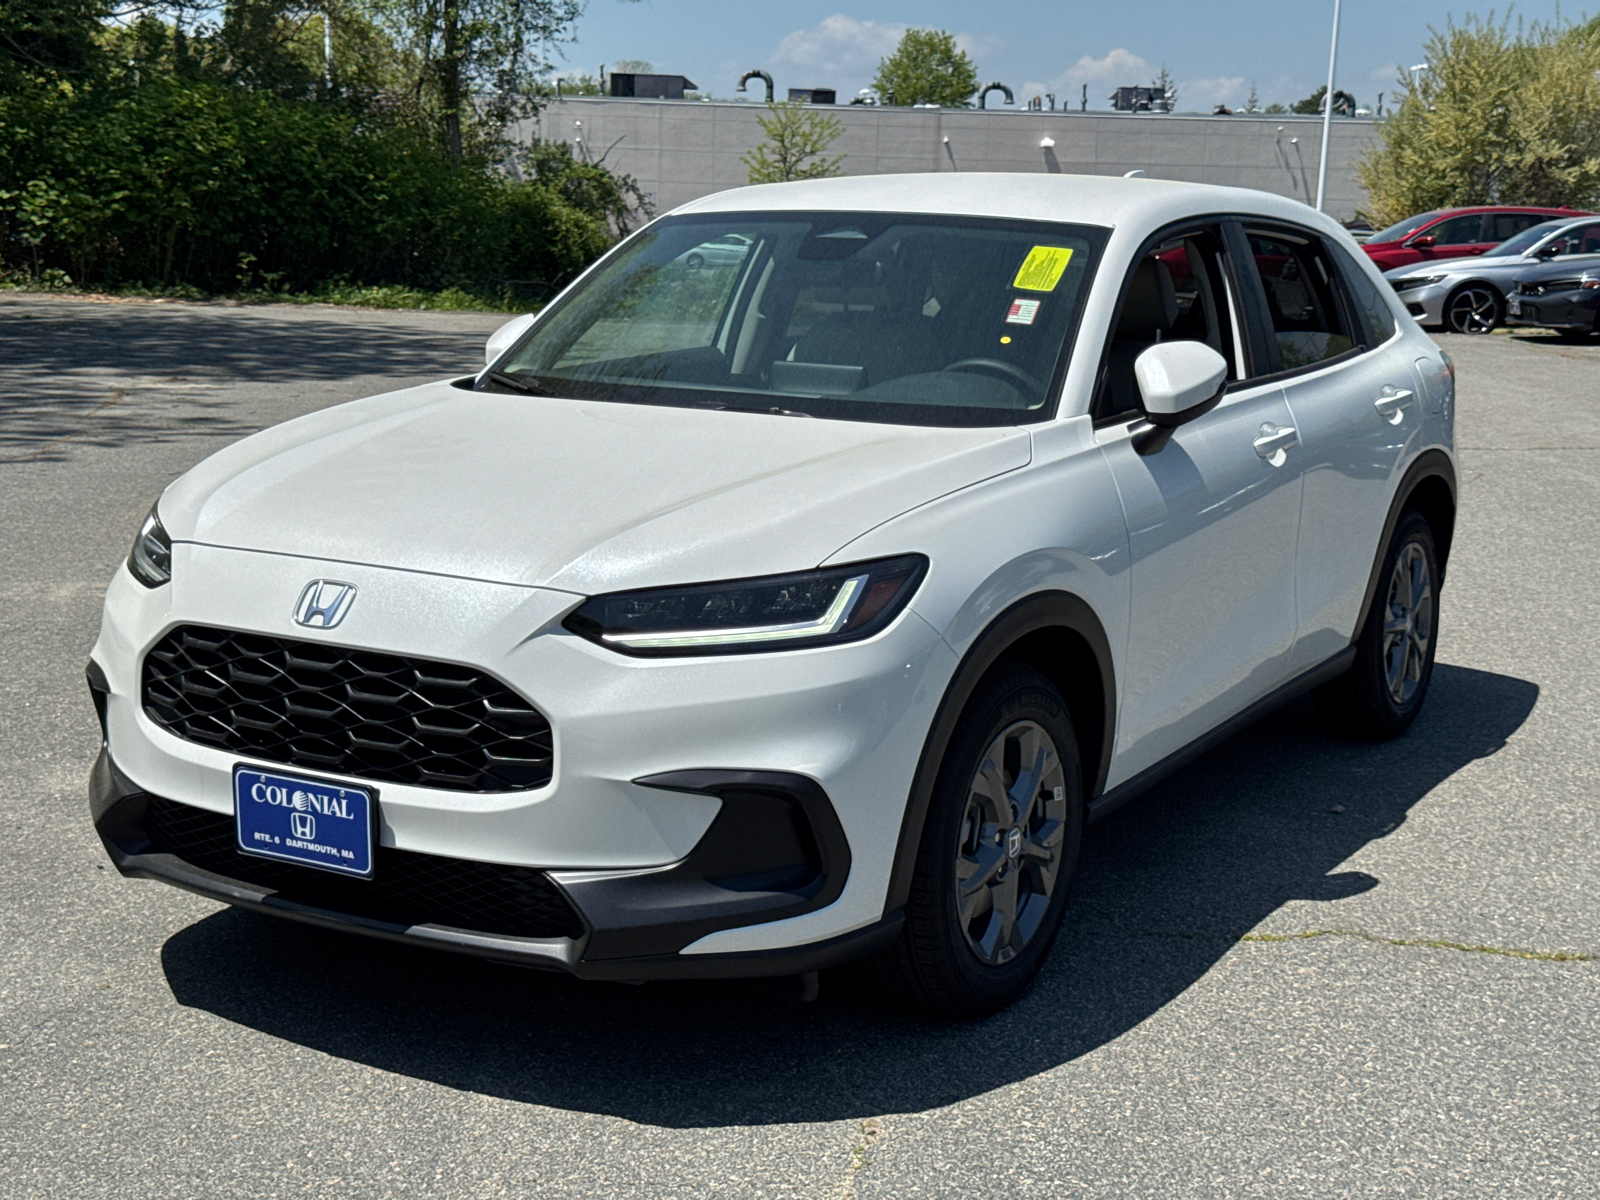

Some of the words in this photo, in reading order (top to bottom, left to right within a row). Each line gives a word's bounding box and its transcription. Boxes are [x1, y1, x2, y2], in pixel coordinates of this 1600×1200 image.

[251, 783, 354, 819] COLONIAL
[254, 831, 273, 843] RTE.
[286, 838, 340, 858] DARTMOUTH,
[341, 849, 355, 859] MA
